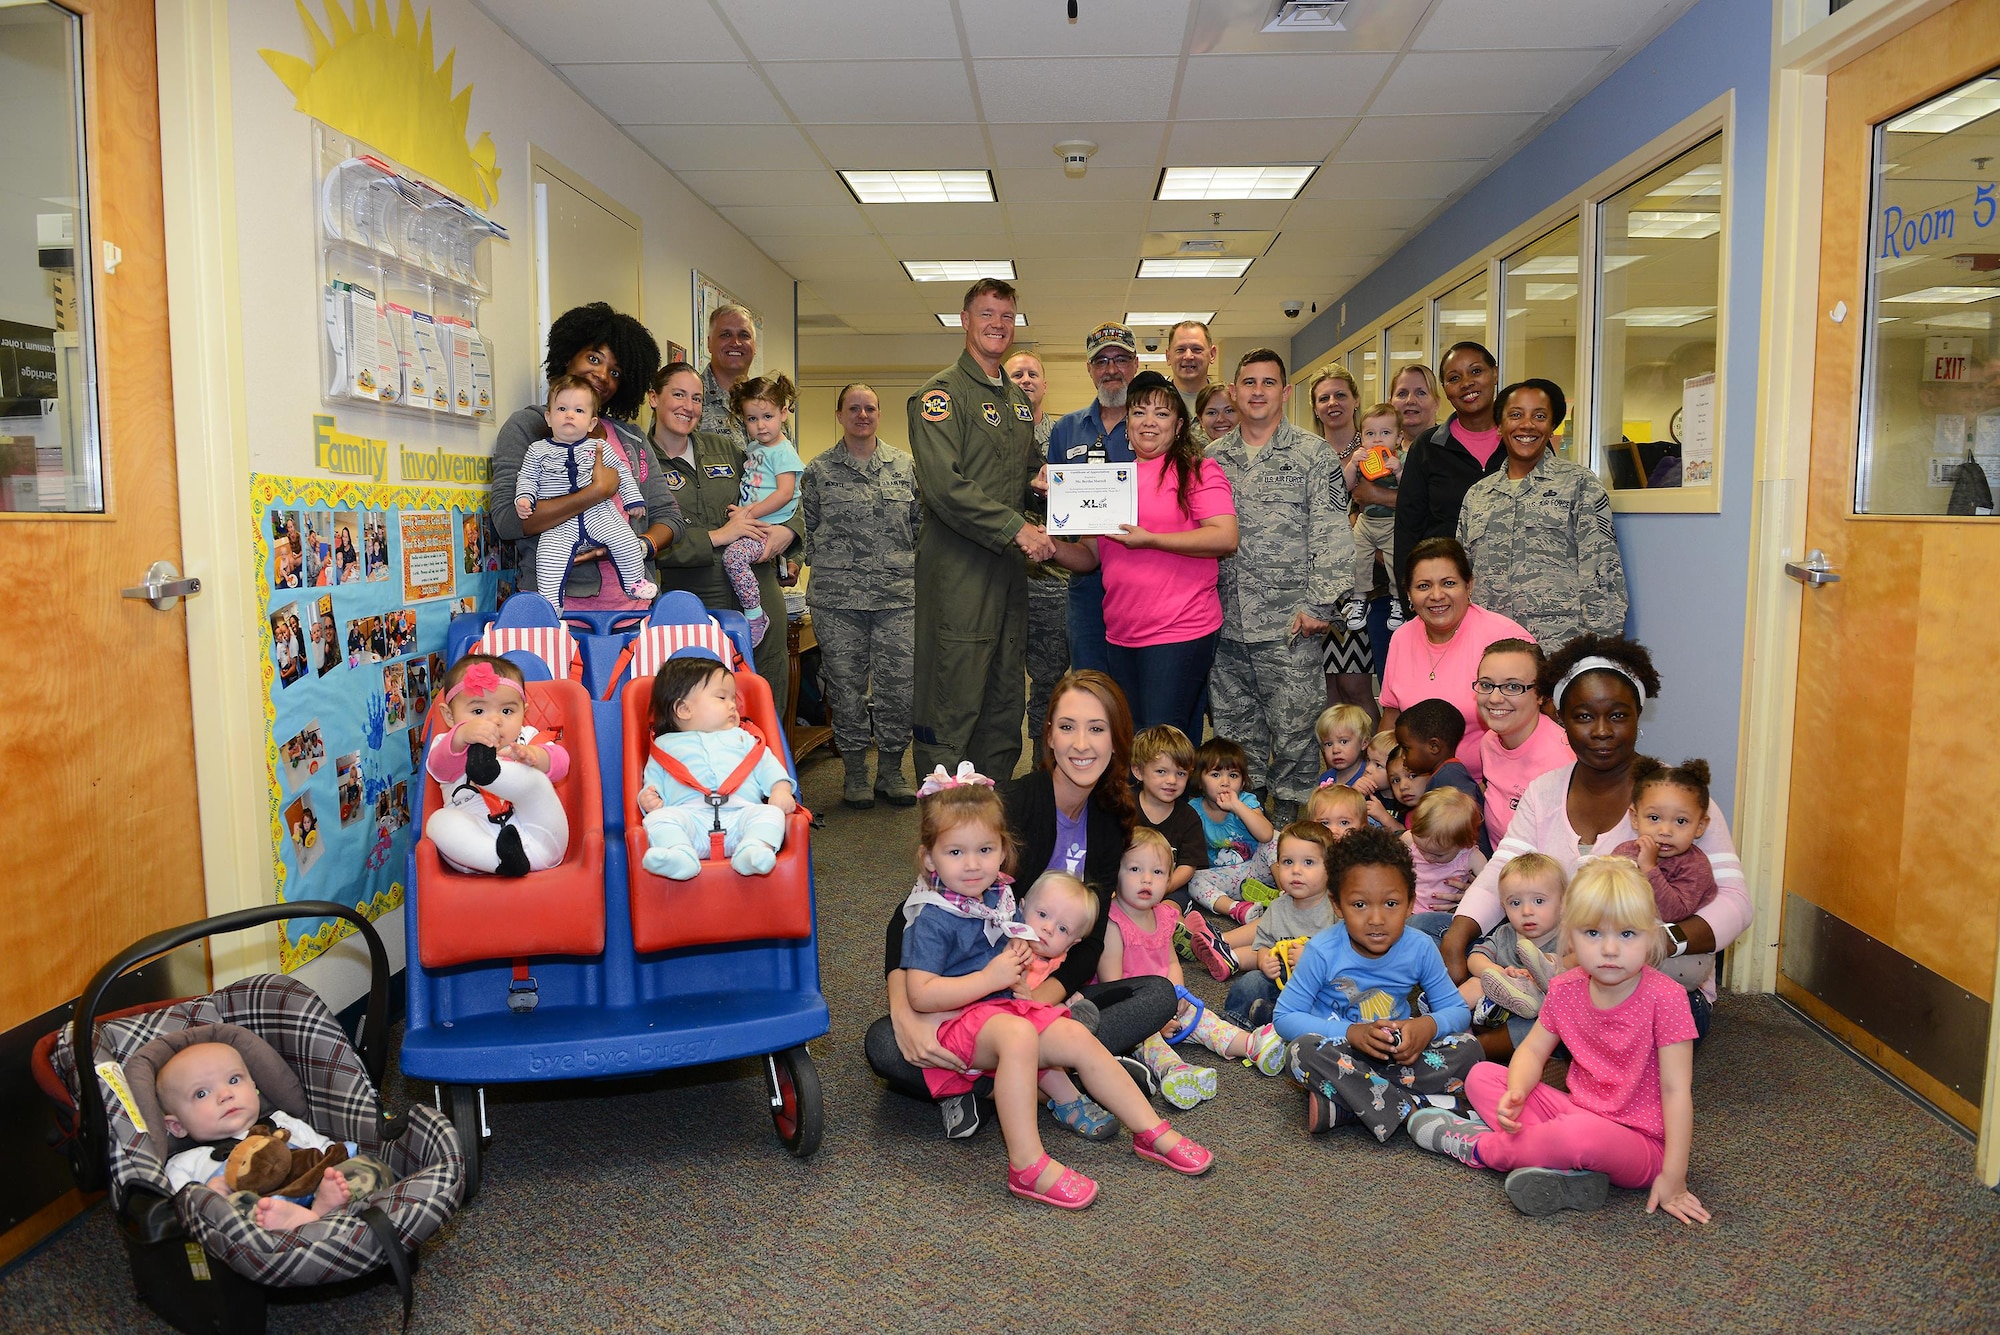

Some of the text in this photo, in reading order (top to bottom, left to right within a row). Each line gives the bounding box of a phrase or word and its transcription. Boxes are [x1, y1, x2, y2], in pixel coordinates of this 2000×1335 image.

[1881, 183, 1997, 259] Room 5
[0, 338, 56, 354] remium Toner
[21, 366, 57, 381] Cartridge
[1935, 357, 1965, 380] EXIT
[314, 415, 386, 483] Family
[400, 444, 494, 481] involvemen
[529, 1038, 716, 1077] bye bye buggy
